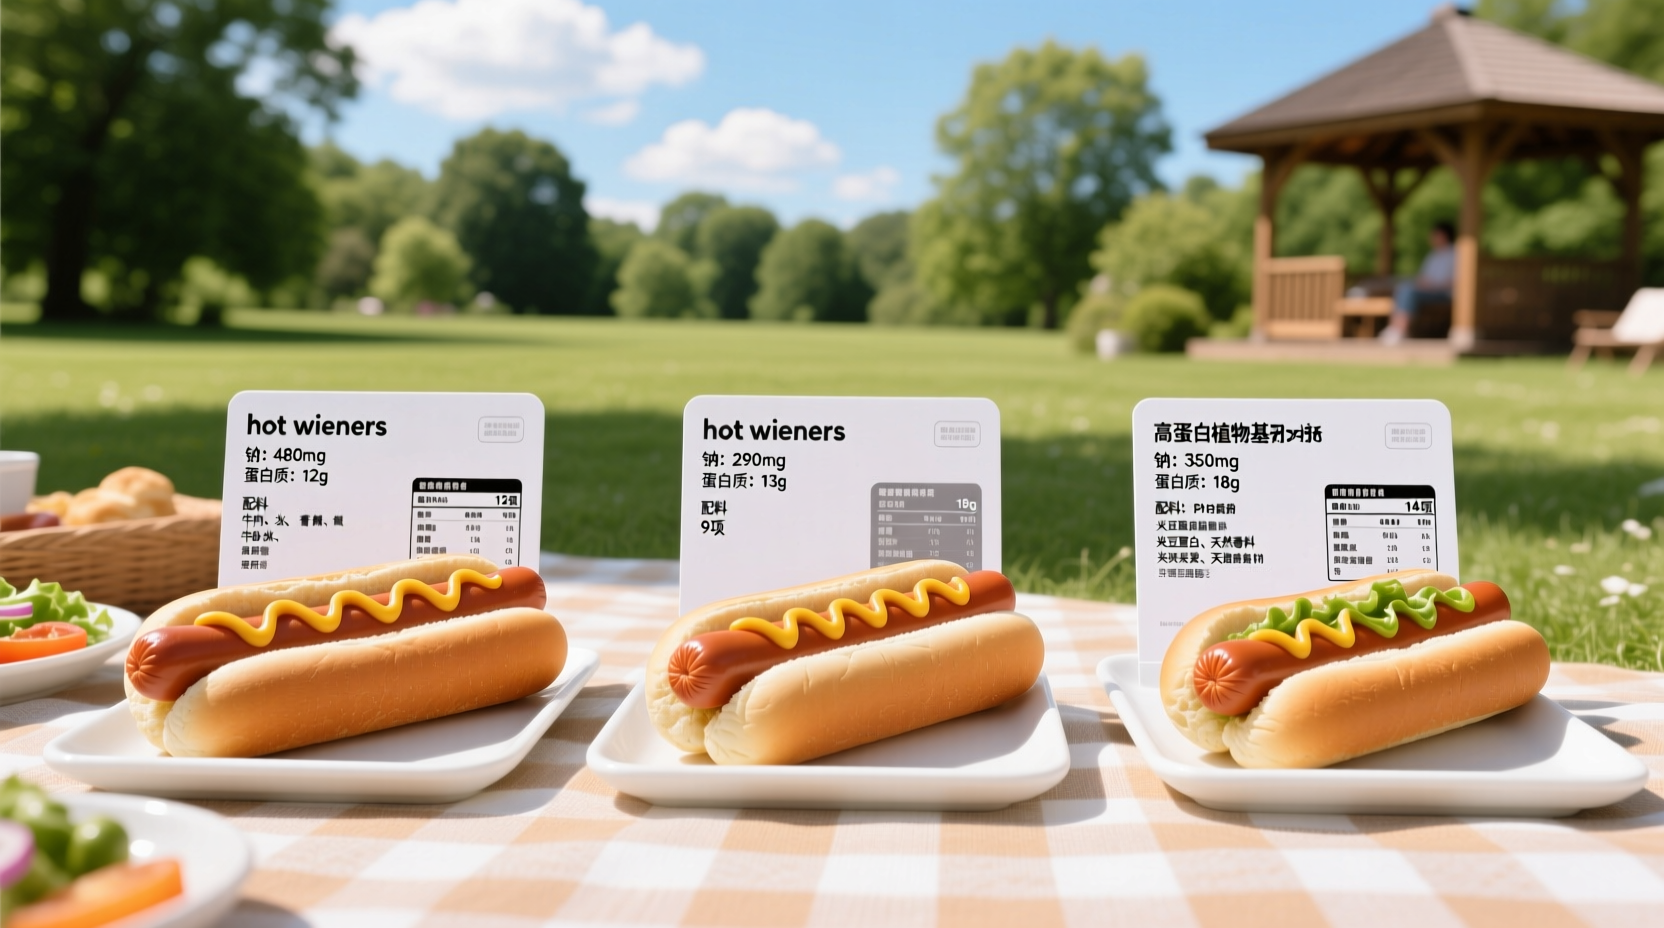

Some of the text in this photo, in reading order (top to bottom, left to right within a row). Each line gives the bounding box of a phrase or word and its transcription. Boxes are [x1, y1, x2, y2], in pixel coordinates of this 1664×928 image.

[247, 413, 387, 436] hot wieners
[703, 418, 846, 441] hot wieners
[242, 496, 268, 511] 配料
[701, 500, 727, 516] 配料
[701, 520, 726, 536] 9项
